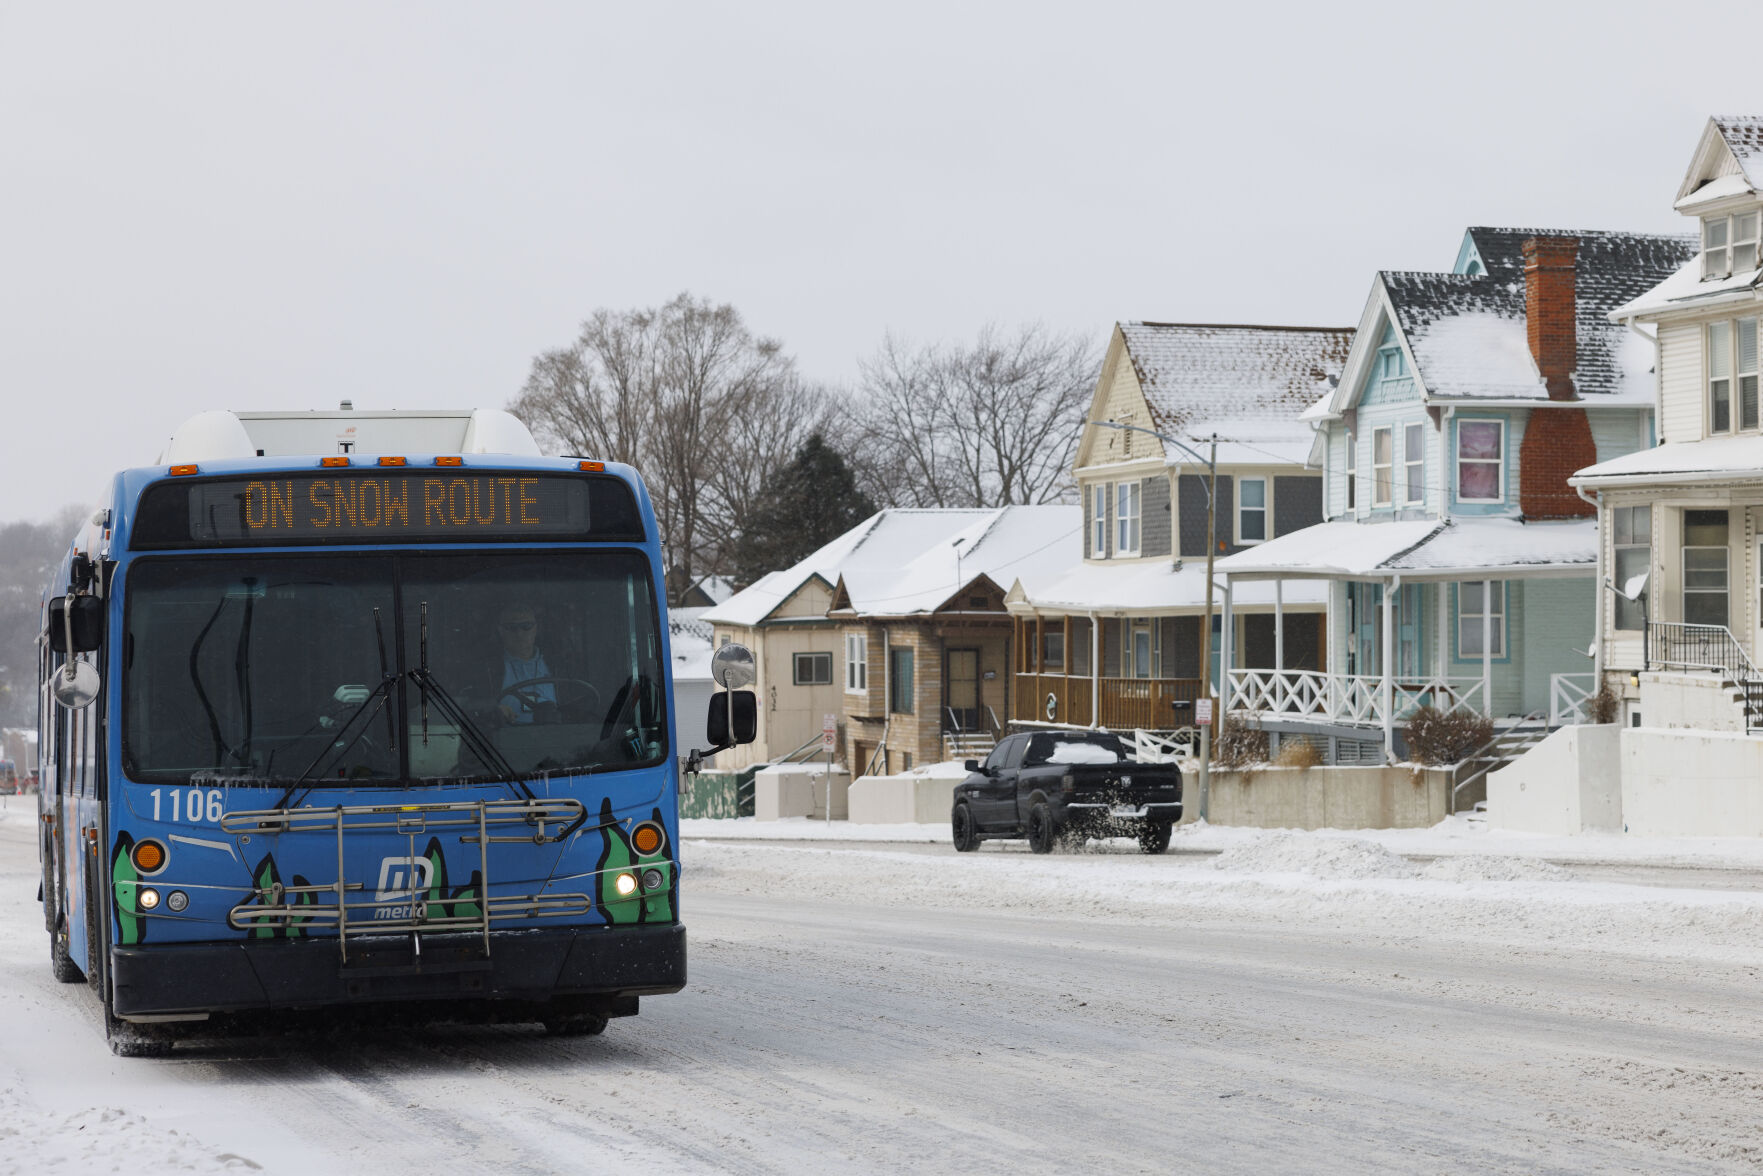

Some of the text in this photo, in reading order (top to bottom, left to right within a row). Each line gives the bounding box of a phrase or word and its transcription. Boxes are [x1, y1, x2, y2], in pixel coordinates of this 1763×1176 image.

[246, 478, 541, 528] ON SNOW ROUTE
[150, 788, 223, 822] 1106
